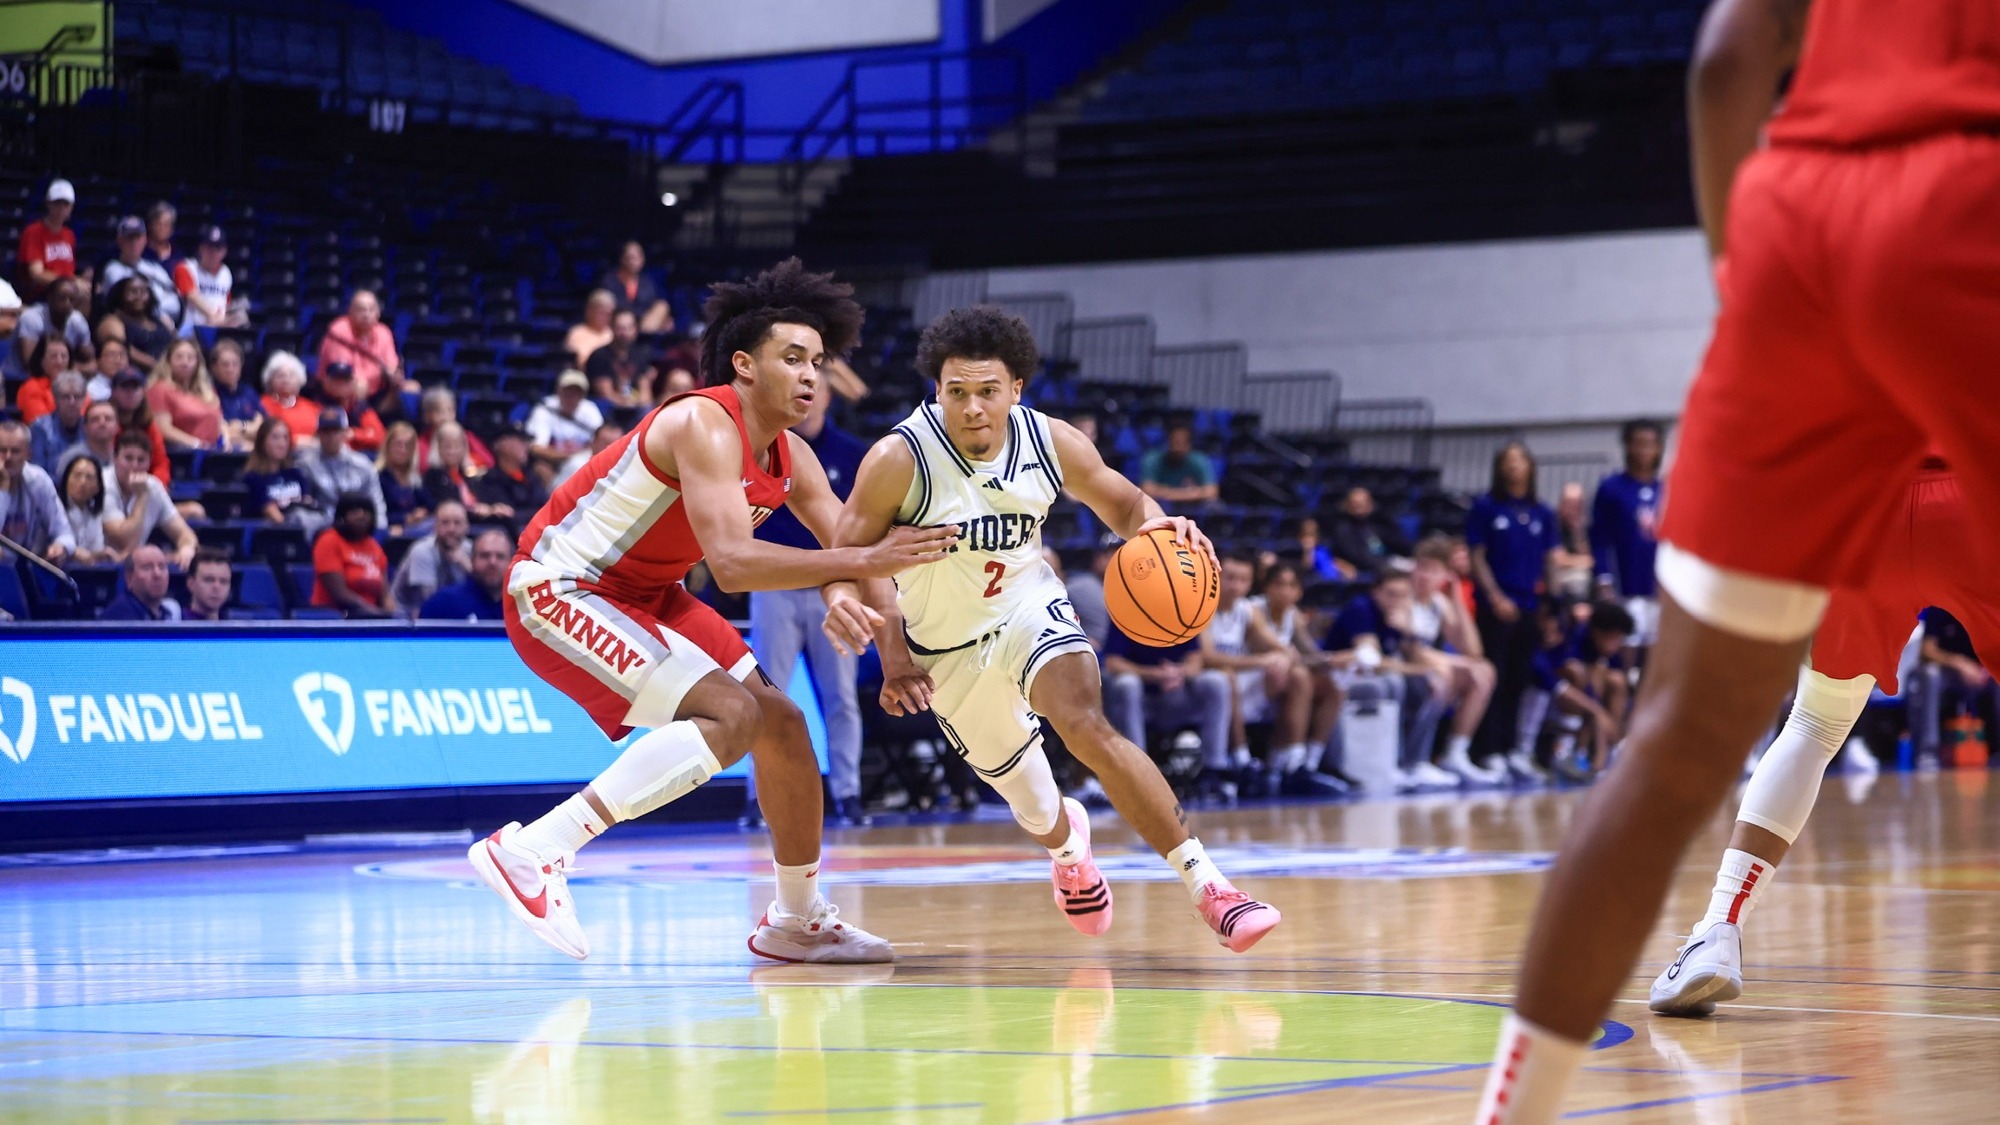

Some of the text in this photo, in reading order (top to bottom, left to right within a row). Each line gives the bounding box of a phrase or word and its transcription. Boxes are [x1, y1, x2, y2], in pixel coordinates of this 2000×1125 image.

[370, 99, 406, 134] 107
[932, 513, 1045, 553] PIDER
[983, 560, 1006, 598] 2
[527, 579, 646, 675] RUNNIN'
[48, 692, 264, 744] FANDUEL
[363, 687, 552, 737] FANDUEL
